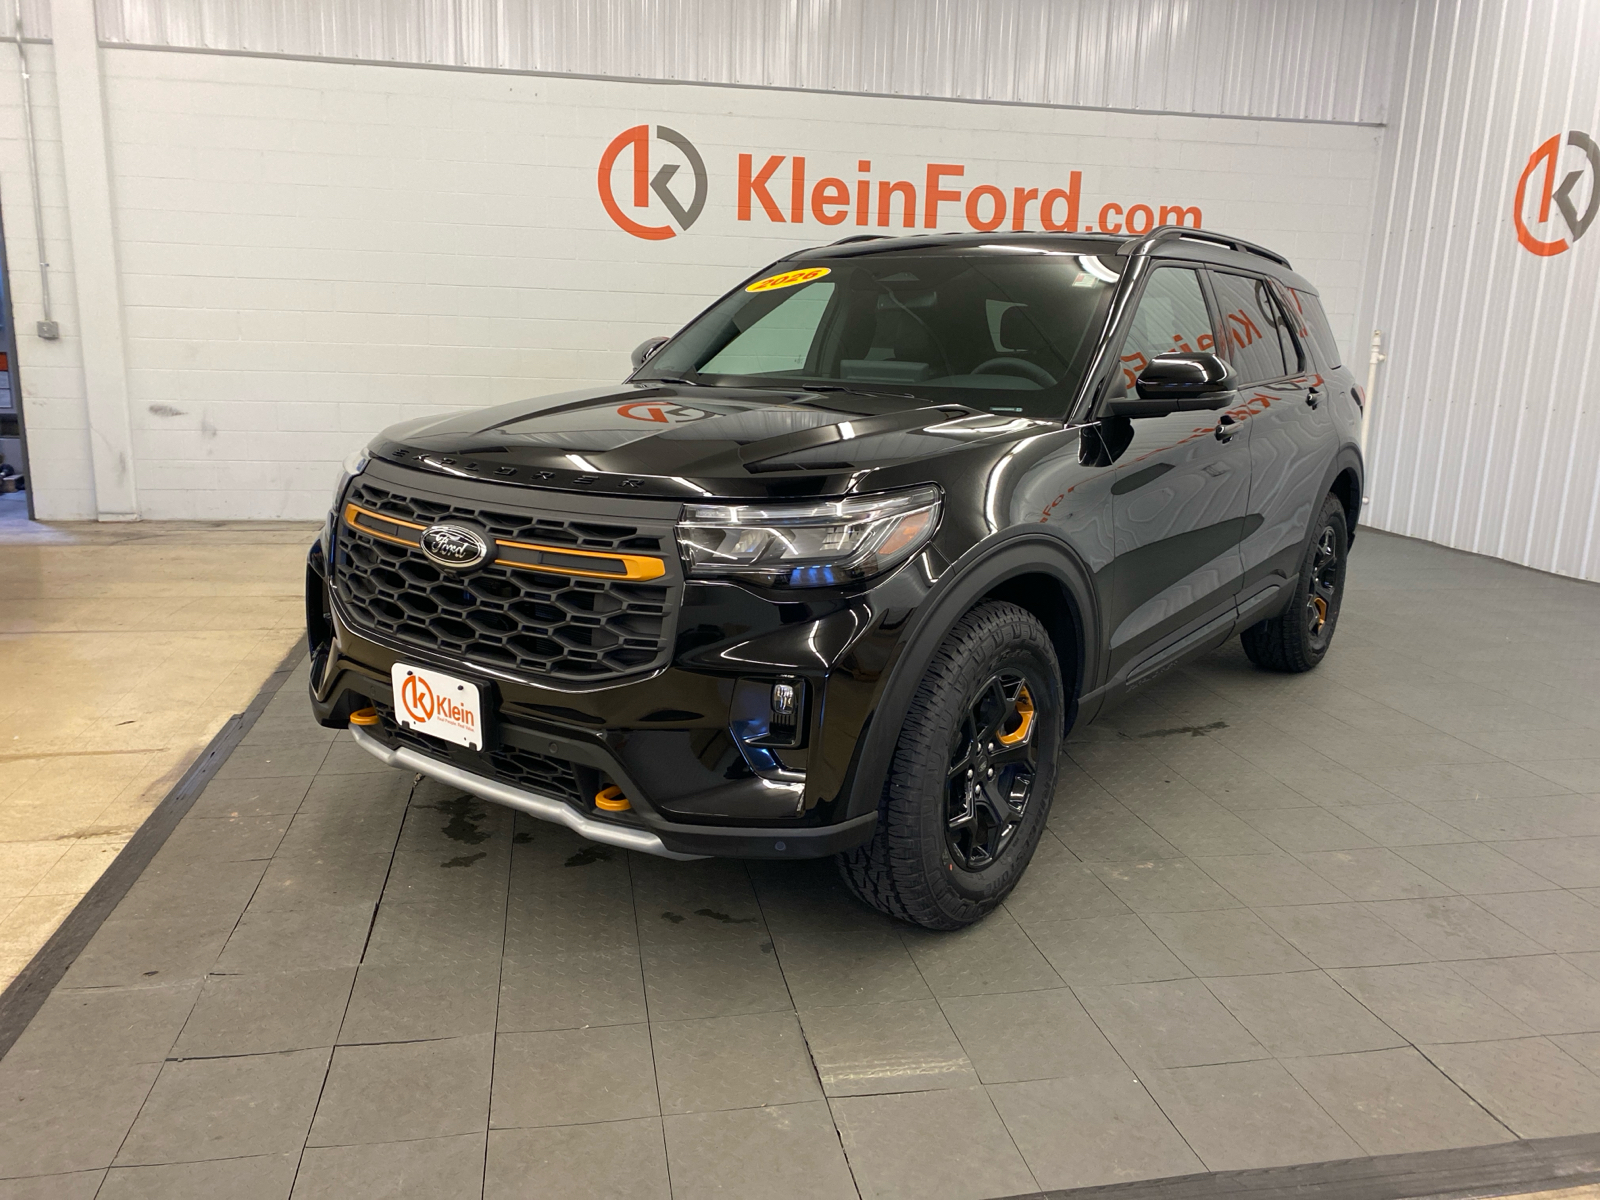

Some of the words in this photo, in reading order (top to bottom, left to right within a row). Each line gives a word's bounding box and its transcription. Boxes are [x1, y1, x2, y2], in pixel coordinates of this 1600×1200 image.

[736, 152, 1204, 236] KleinFord.com
[752, 269, 823, 291] 2026
[391, 447, 645, 489] EXPLORER
[431, 531, 468, 560] Ford
[436, 695, 475, 727] Klein
